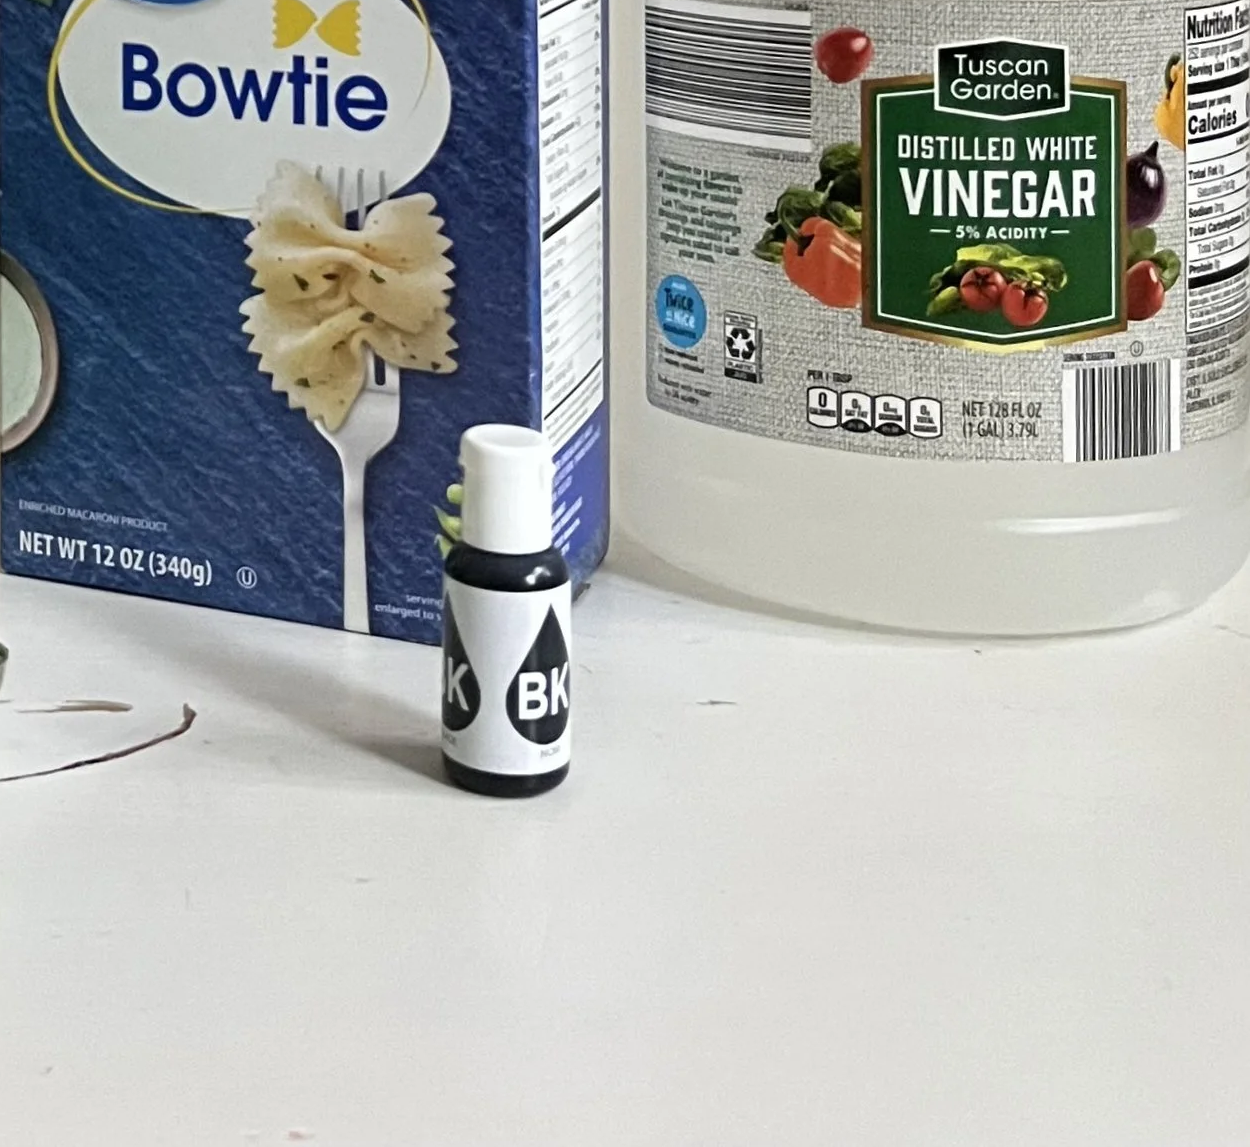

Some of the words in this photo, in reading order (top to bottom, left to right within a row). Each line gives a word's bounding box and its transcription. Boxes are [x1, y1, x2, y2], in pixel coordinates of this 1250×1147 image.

[1187, 10, 1233, 40] Nutrition
[954, 54, 1048, 75] Tuscan
[122, 42, 388, 131] Bowtie
[951, 78, 1051, 100] Garden
[1188, 108, 1236, 135] Calories
[898, 134, 1015, 161] DISTILLED
[1026, 135, 1097, 161] WHITE
[899, 167, 1095, 218] VINEGAR
[955, 225, 980, 239] 5%
[986, 226, 1047, 239] ACIDITY
[818, 393, 827, 407] 0
[962, 402, 985, 417] NET
[989, 402, 1009, 417] 128
[1012, 402, 1024, 418] FL
[1027, 402, 1042, 417] OZ
[18, 499, 64, 515] ENRICHED
[67, 507, 120, 525] MACARONI
[121, 516, 169, 532] PRODUCT
[19, 530, 54, 556] NET
[58, 536, 87, 562] WT
[92, 544, 115, 567] 12
[119, 549, 144, 572] OZ
[149, 551, 212, 586] (340g)
[375, 604, 420, 618] enlarged
[423, 610, 434, 620] to
[518, 662, 569, 720] BK
